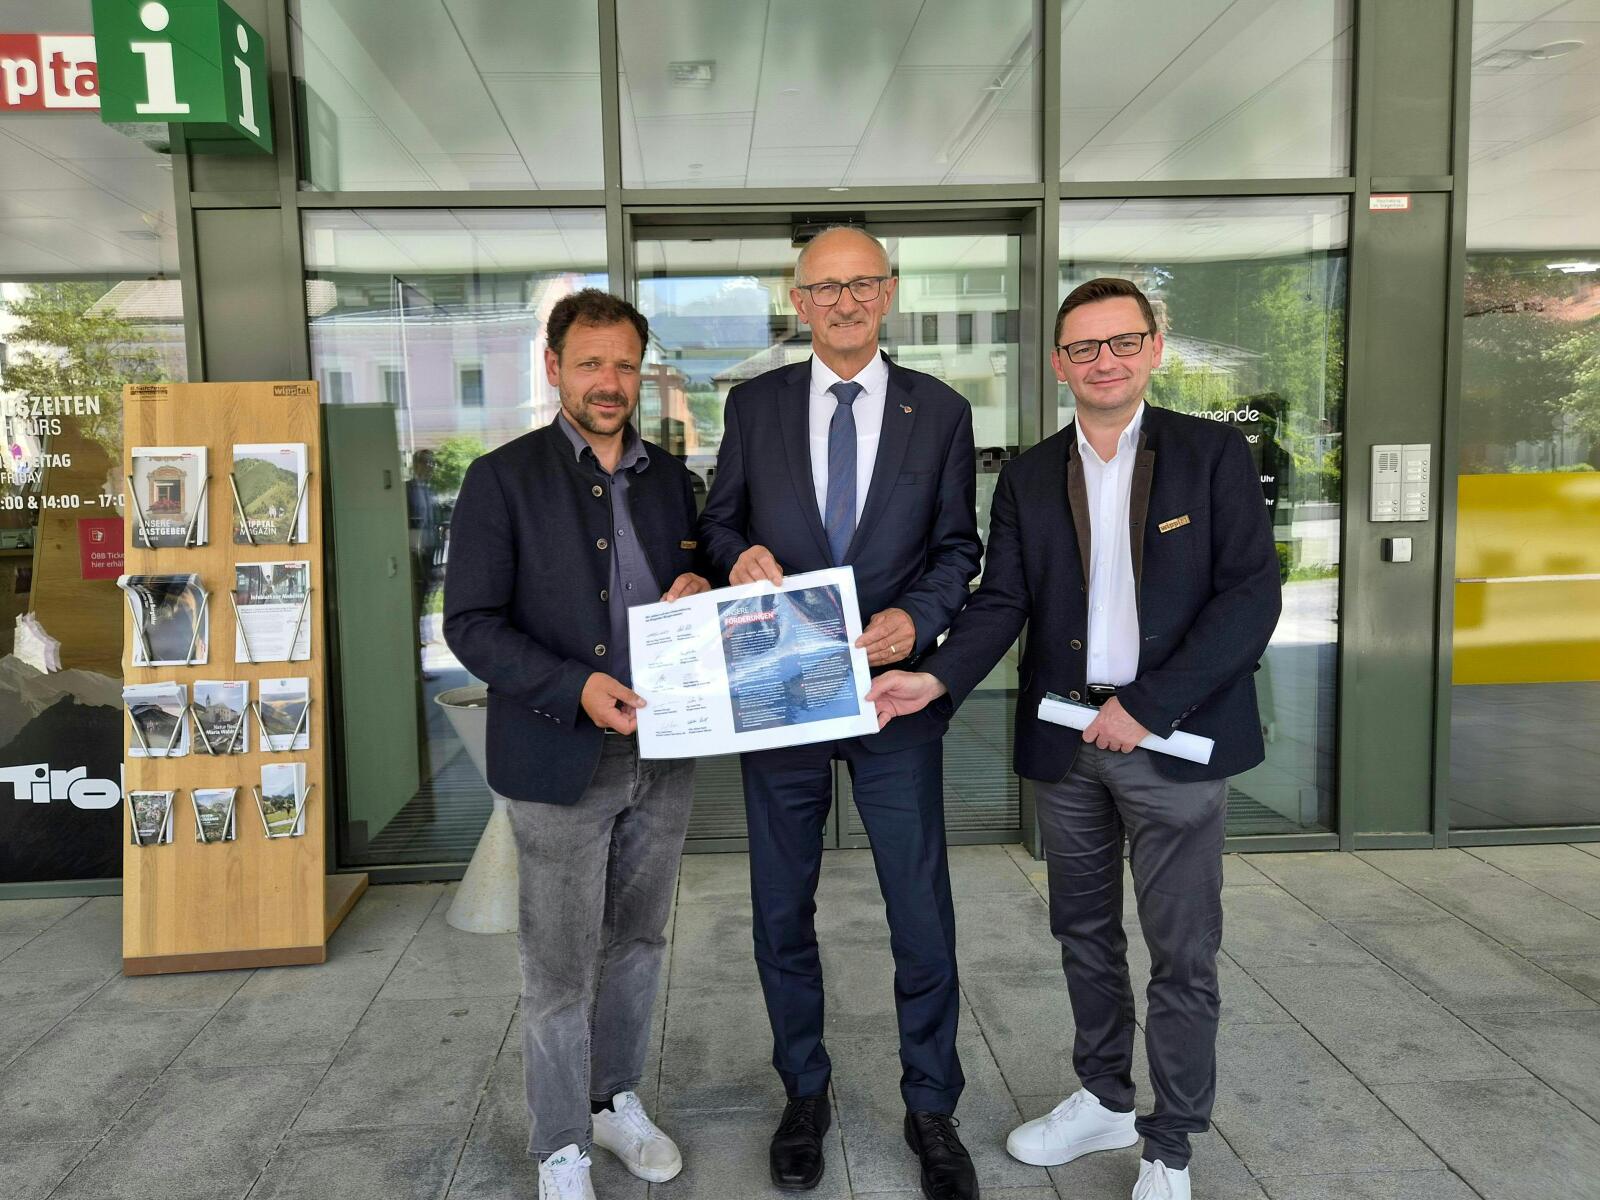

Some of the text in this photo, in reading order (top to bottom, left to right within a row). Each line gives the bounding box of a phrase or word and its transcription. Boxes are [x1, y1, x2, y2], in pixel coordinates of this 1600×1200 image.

[131, 2, 190, 113] i
[234, 24, 260, 137] i
[27, 496, 39, 509] &
[40, 495, 80, 509] 14:00
[1260, 475, 1275, 483] Uhr
